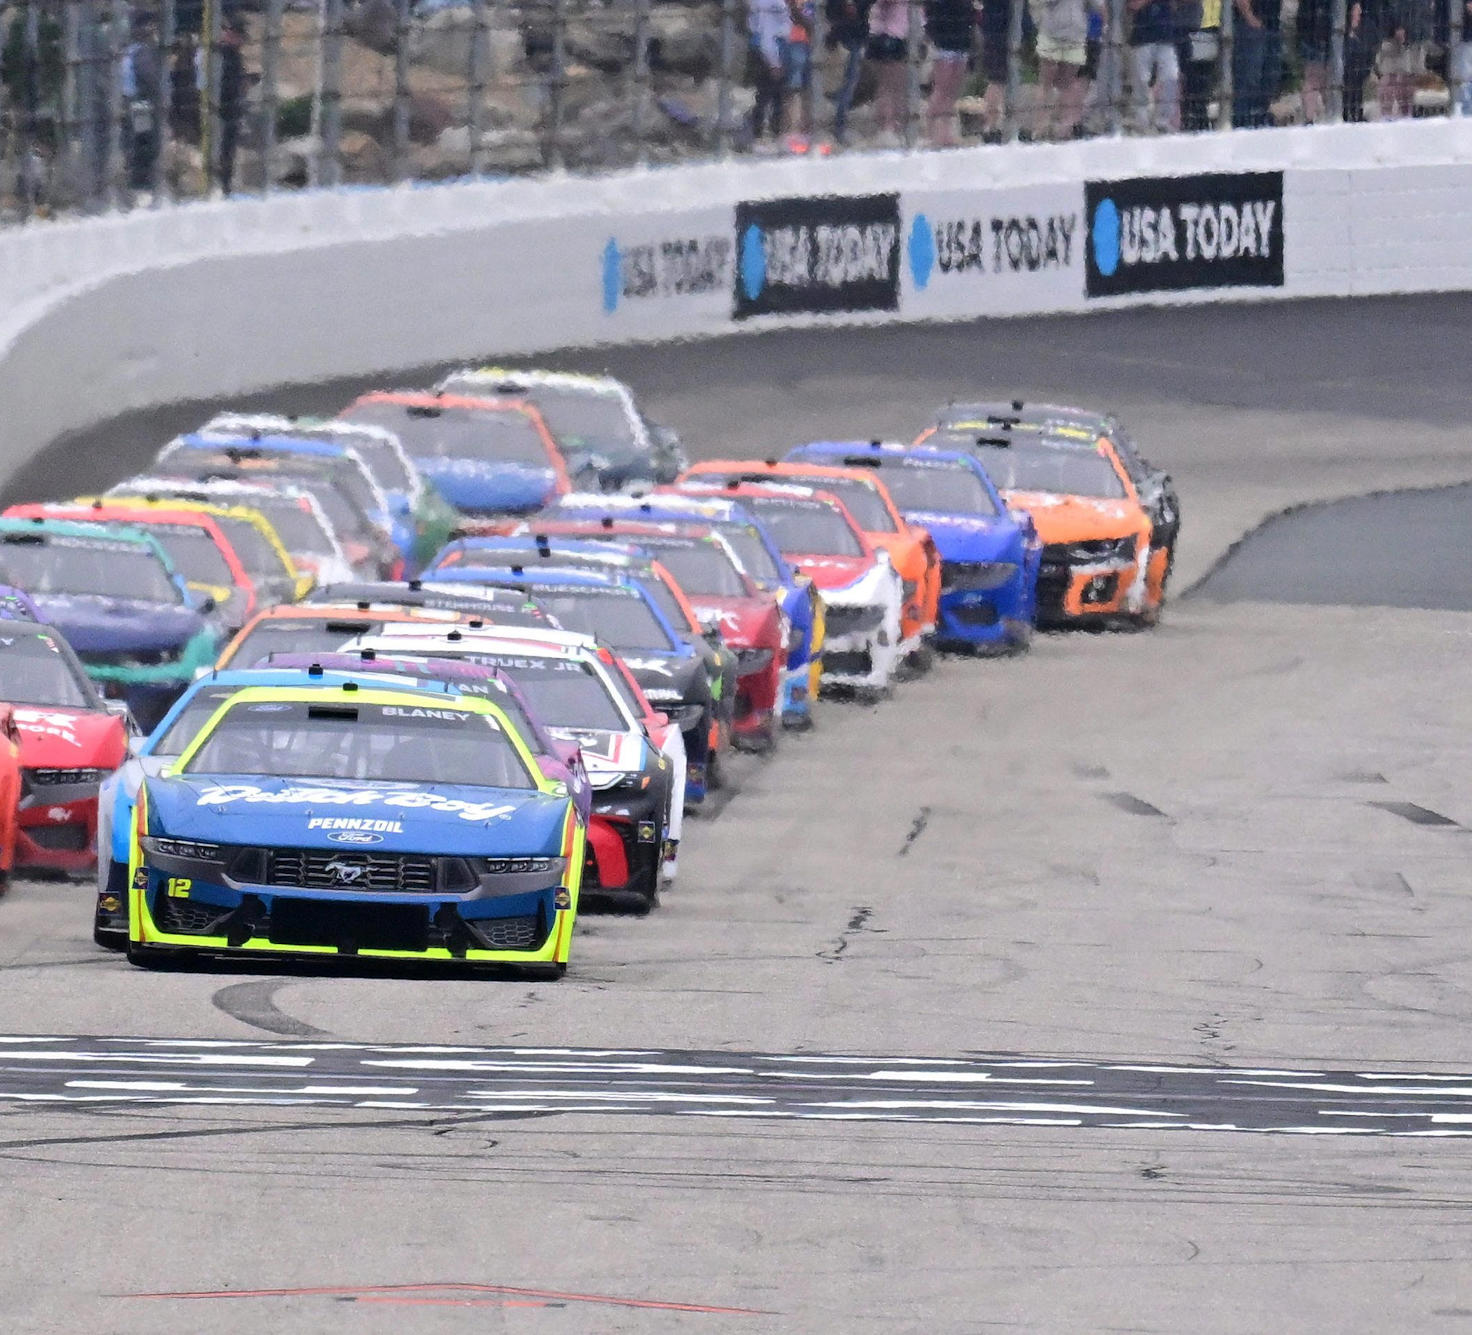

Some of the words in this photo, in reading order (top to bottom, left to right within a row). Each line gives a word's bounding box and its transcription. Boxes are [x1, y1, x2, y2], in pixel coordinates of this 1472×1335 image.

[1120, 207, 1178, 264] USA
[1179, 201, 1275, 260] TODAY
[464, 655, 546, 670] TRUEX
[382, 707, 471, 721] BLANEY
[384, 792, 516, 821] Boy
[308, 818, 404, 833] PENNZOIL
[168, 878, 192, 898] 12
